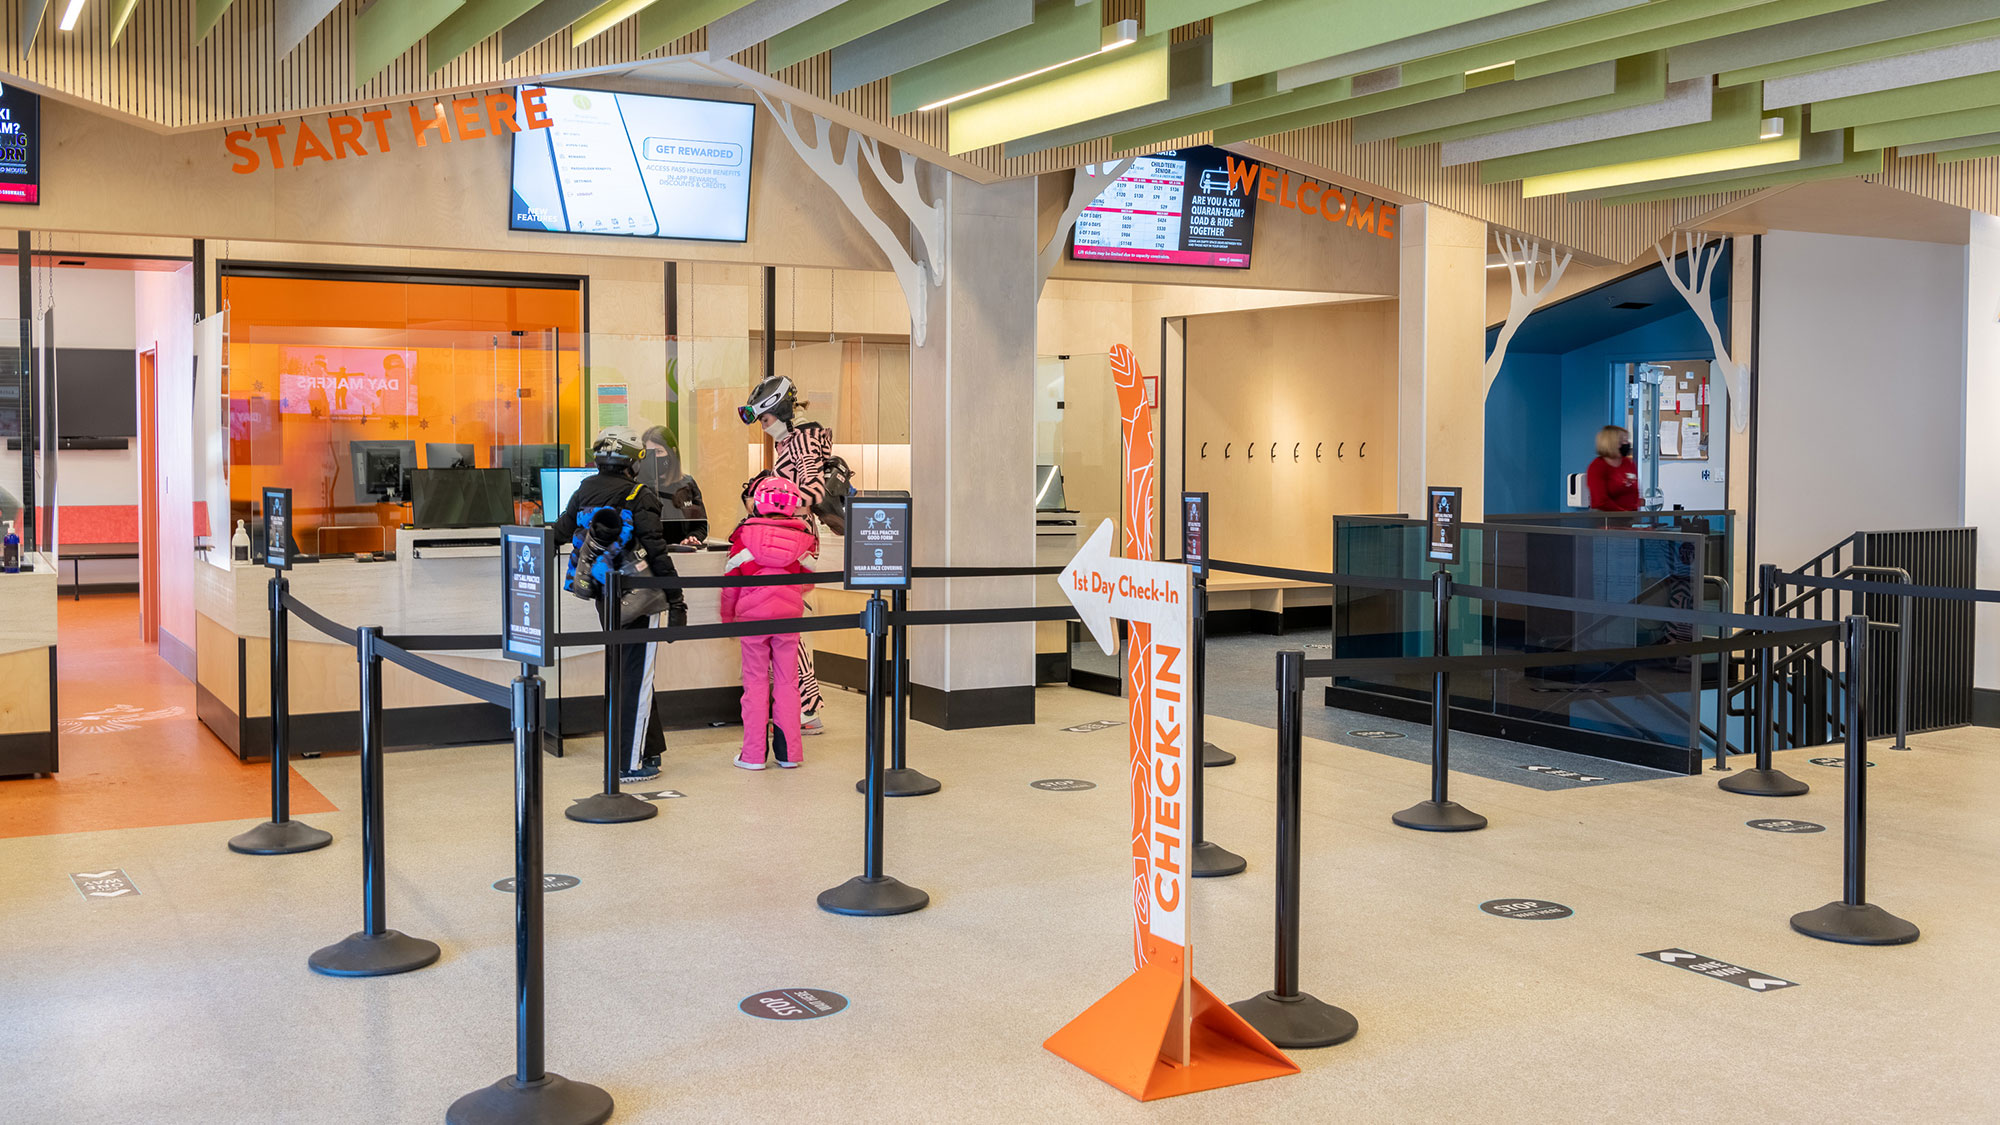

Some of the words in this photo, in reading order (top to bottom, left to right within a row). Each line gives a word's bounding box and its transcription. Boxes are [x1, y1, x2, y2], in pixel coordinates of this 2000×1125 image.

[225, 109, 392, 174] START
[409, 87, 554, 148] HERE
[656, 145, 676, 154] GET
[678, 146, 734, 159] REWARDED
[1192, 196, 1206, 205] ARE
[1207, 196, 1222, 206] YOU
[1222, 198, 1228, 207] A
[1229, 198, 1241, 207] SKI
[1226, 155, 1397, 239] WELCOME
[1191, 206, 1245, 218] QUARAN-TEAM?
[1190, 216, 1209, 225] LOAD
[1210, 217, 1216, 226] &
[1217, 218, 1234, 227] RIDE
[1190, 226, 1225, 237] TOGETHER
[1072, 569, 1088, 592] 1st
[1092, 571, 1115, 604] Day
[1118, 574, 1179, 605] Check-In
[1154, 643, 1181, 912] CHECK-IN
[1493, 901, 1538, 912] STOP
[1689, 961, 1728, 971] ONE
[1706, 966, 1747, 977] WAY
[759, 998, 803, 1016] STOP
